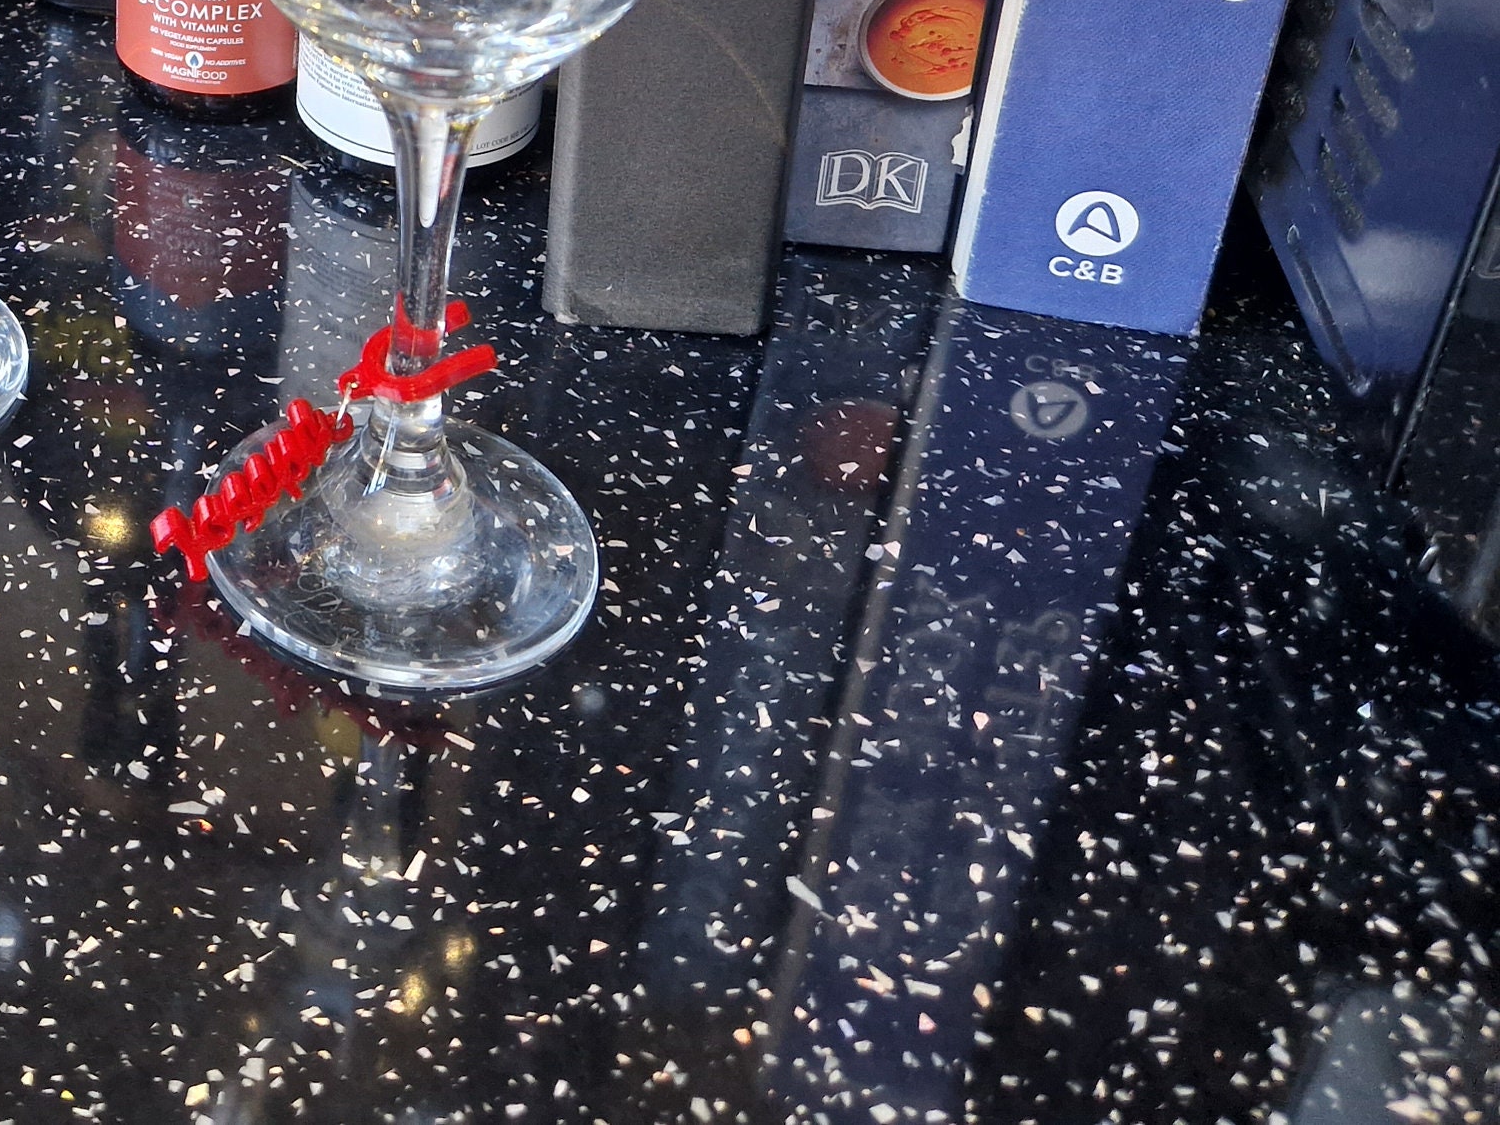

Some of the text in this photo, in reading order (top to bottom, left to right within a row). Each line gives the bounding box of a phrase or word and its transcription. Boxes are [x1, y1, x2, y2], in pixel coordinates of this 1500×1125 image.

[153, 12, 242, 34] WITH VITAMIN C
[160, 28, 205, 45] VEGETARIAN
[206, 36, 244, 46] CAPSULES
[825, 152, 916, 204] DK
[1048, 256, 1124, 285] C&B
